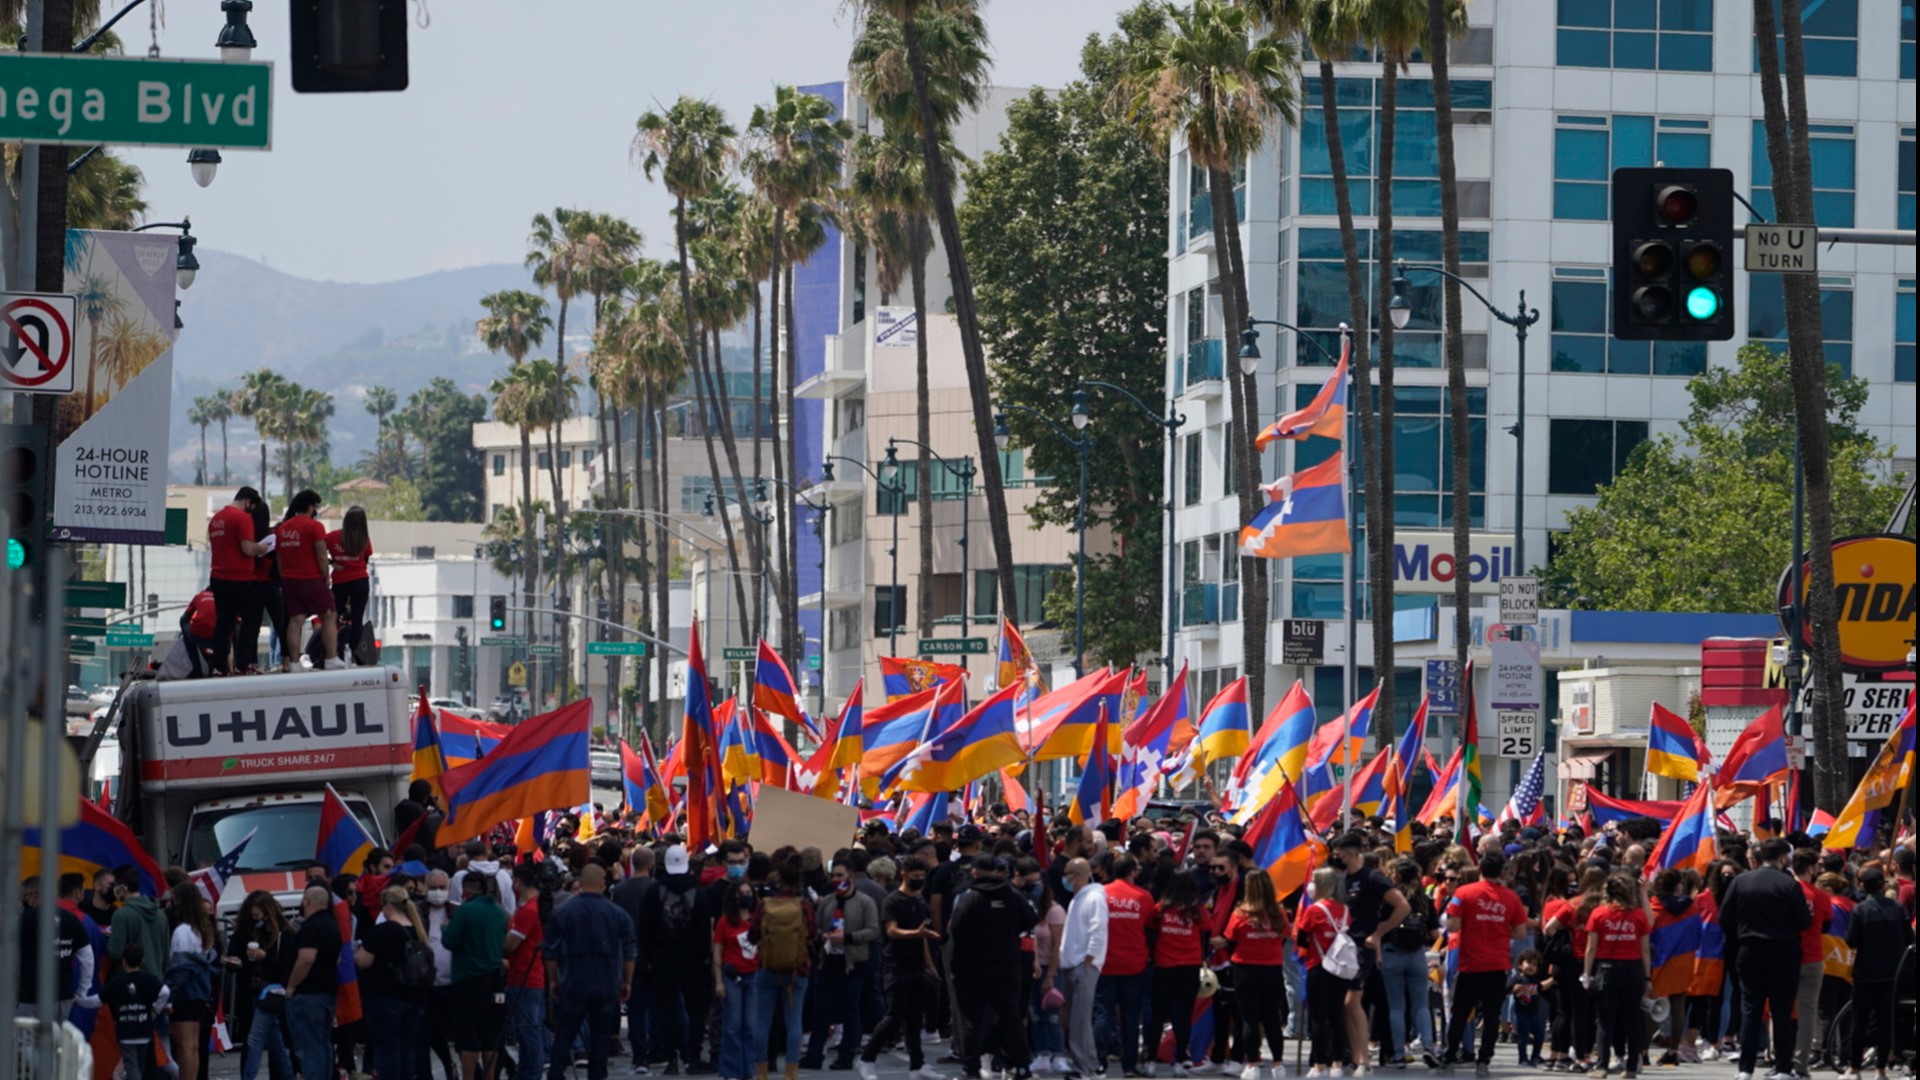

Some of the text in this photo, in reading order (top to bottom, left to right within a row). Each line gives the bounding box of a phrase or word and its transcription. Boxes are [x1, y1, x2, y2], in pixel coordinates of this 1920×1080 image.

[138, 81, 256, 127] Blvd
[1758, 230, 1804, 250] NO U
[1759, 253, 1804, 268] TURN
[75, 447, 149, 464] 24-HOUR
[75, 464, 149, 481] HOTLINE
[90, 487, 133, 499] METRO
[1502, 583, 1536, 594] DO NOT
[1502, 599, 1536, 610] BLOCK
[923, 642, 984, 651] CARSON RD
[165, 702, 384, 747] U-HAUL
[1501, 715, 1534, 724] SPEED
[1502, 737, 1532, 755] 25
[240, 754, 336, 769] TRUCK SHARE 24/7
[1109, 911, 1140, 919] MONITOR
